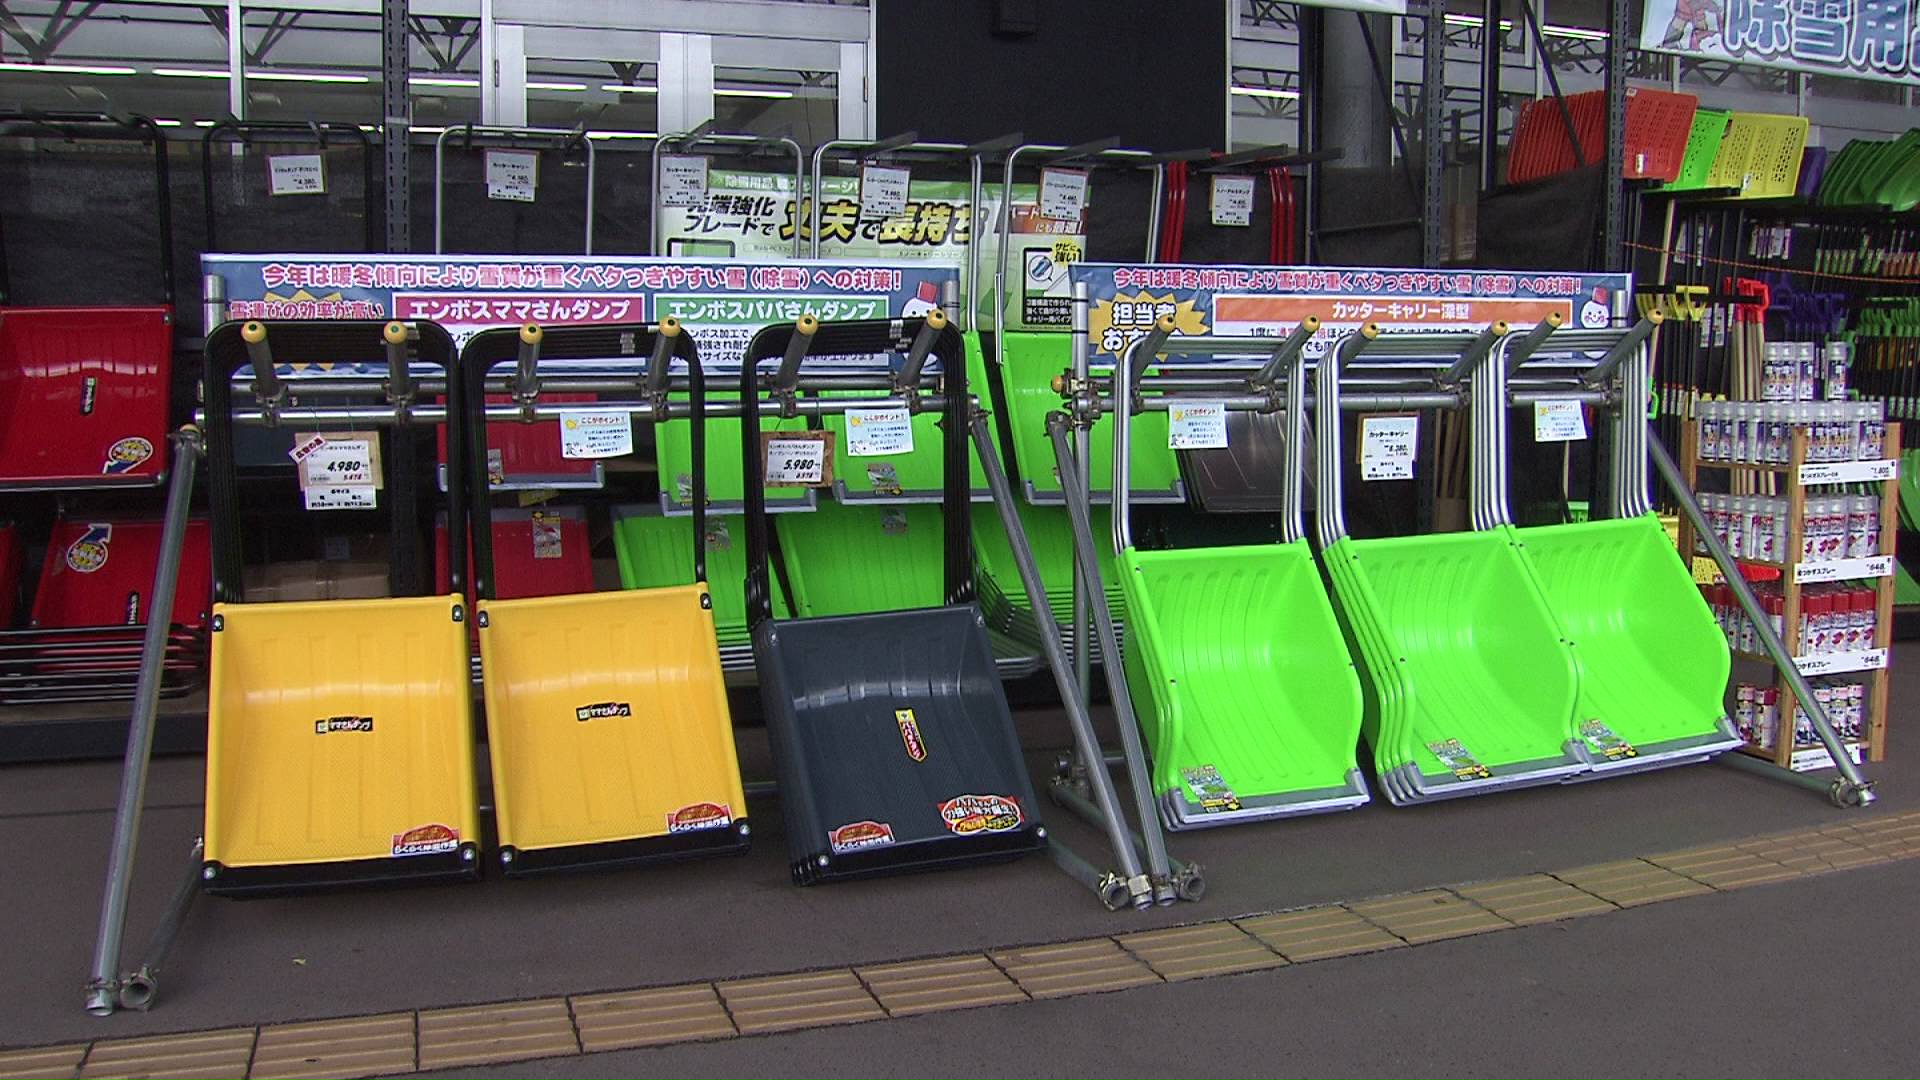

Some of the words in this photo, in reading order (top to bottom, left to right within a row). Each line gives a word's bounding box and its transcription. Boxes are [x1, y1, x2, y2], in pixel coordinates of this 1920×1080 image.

[408, 299, 631, 322] エンボスママさんダンプ
[667, 300, 878, 322] エンボスパパさんダンプ
[1331, 302, 1471, 321] カッターキャリー深型
